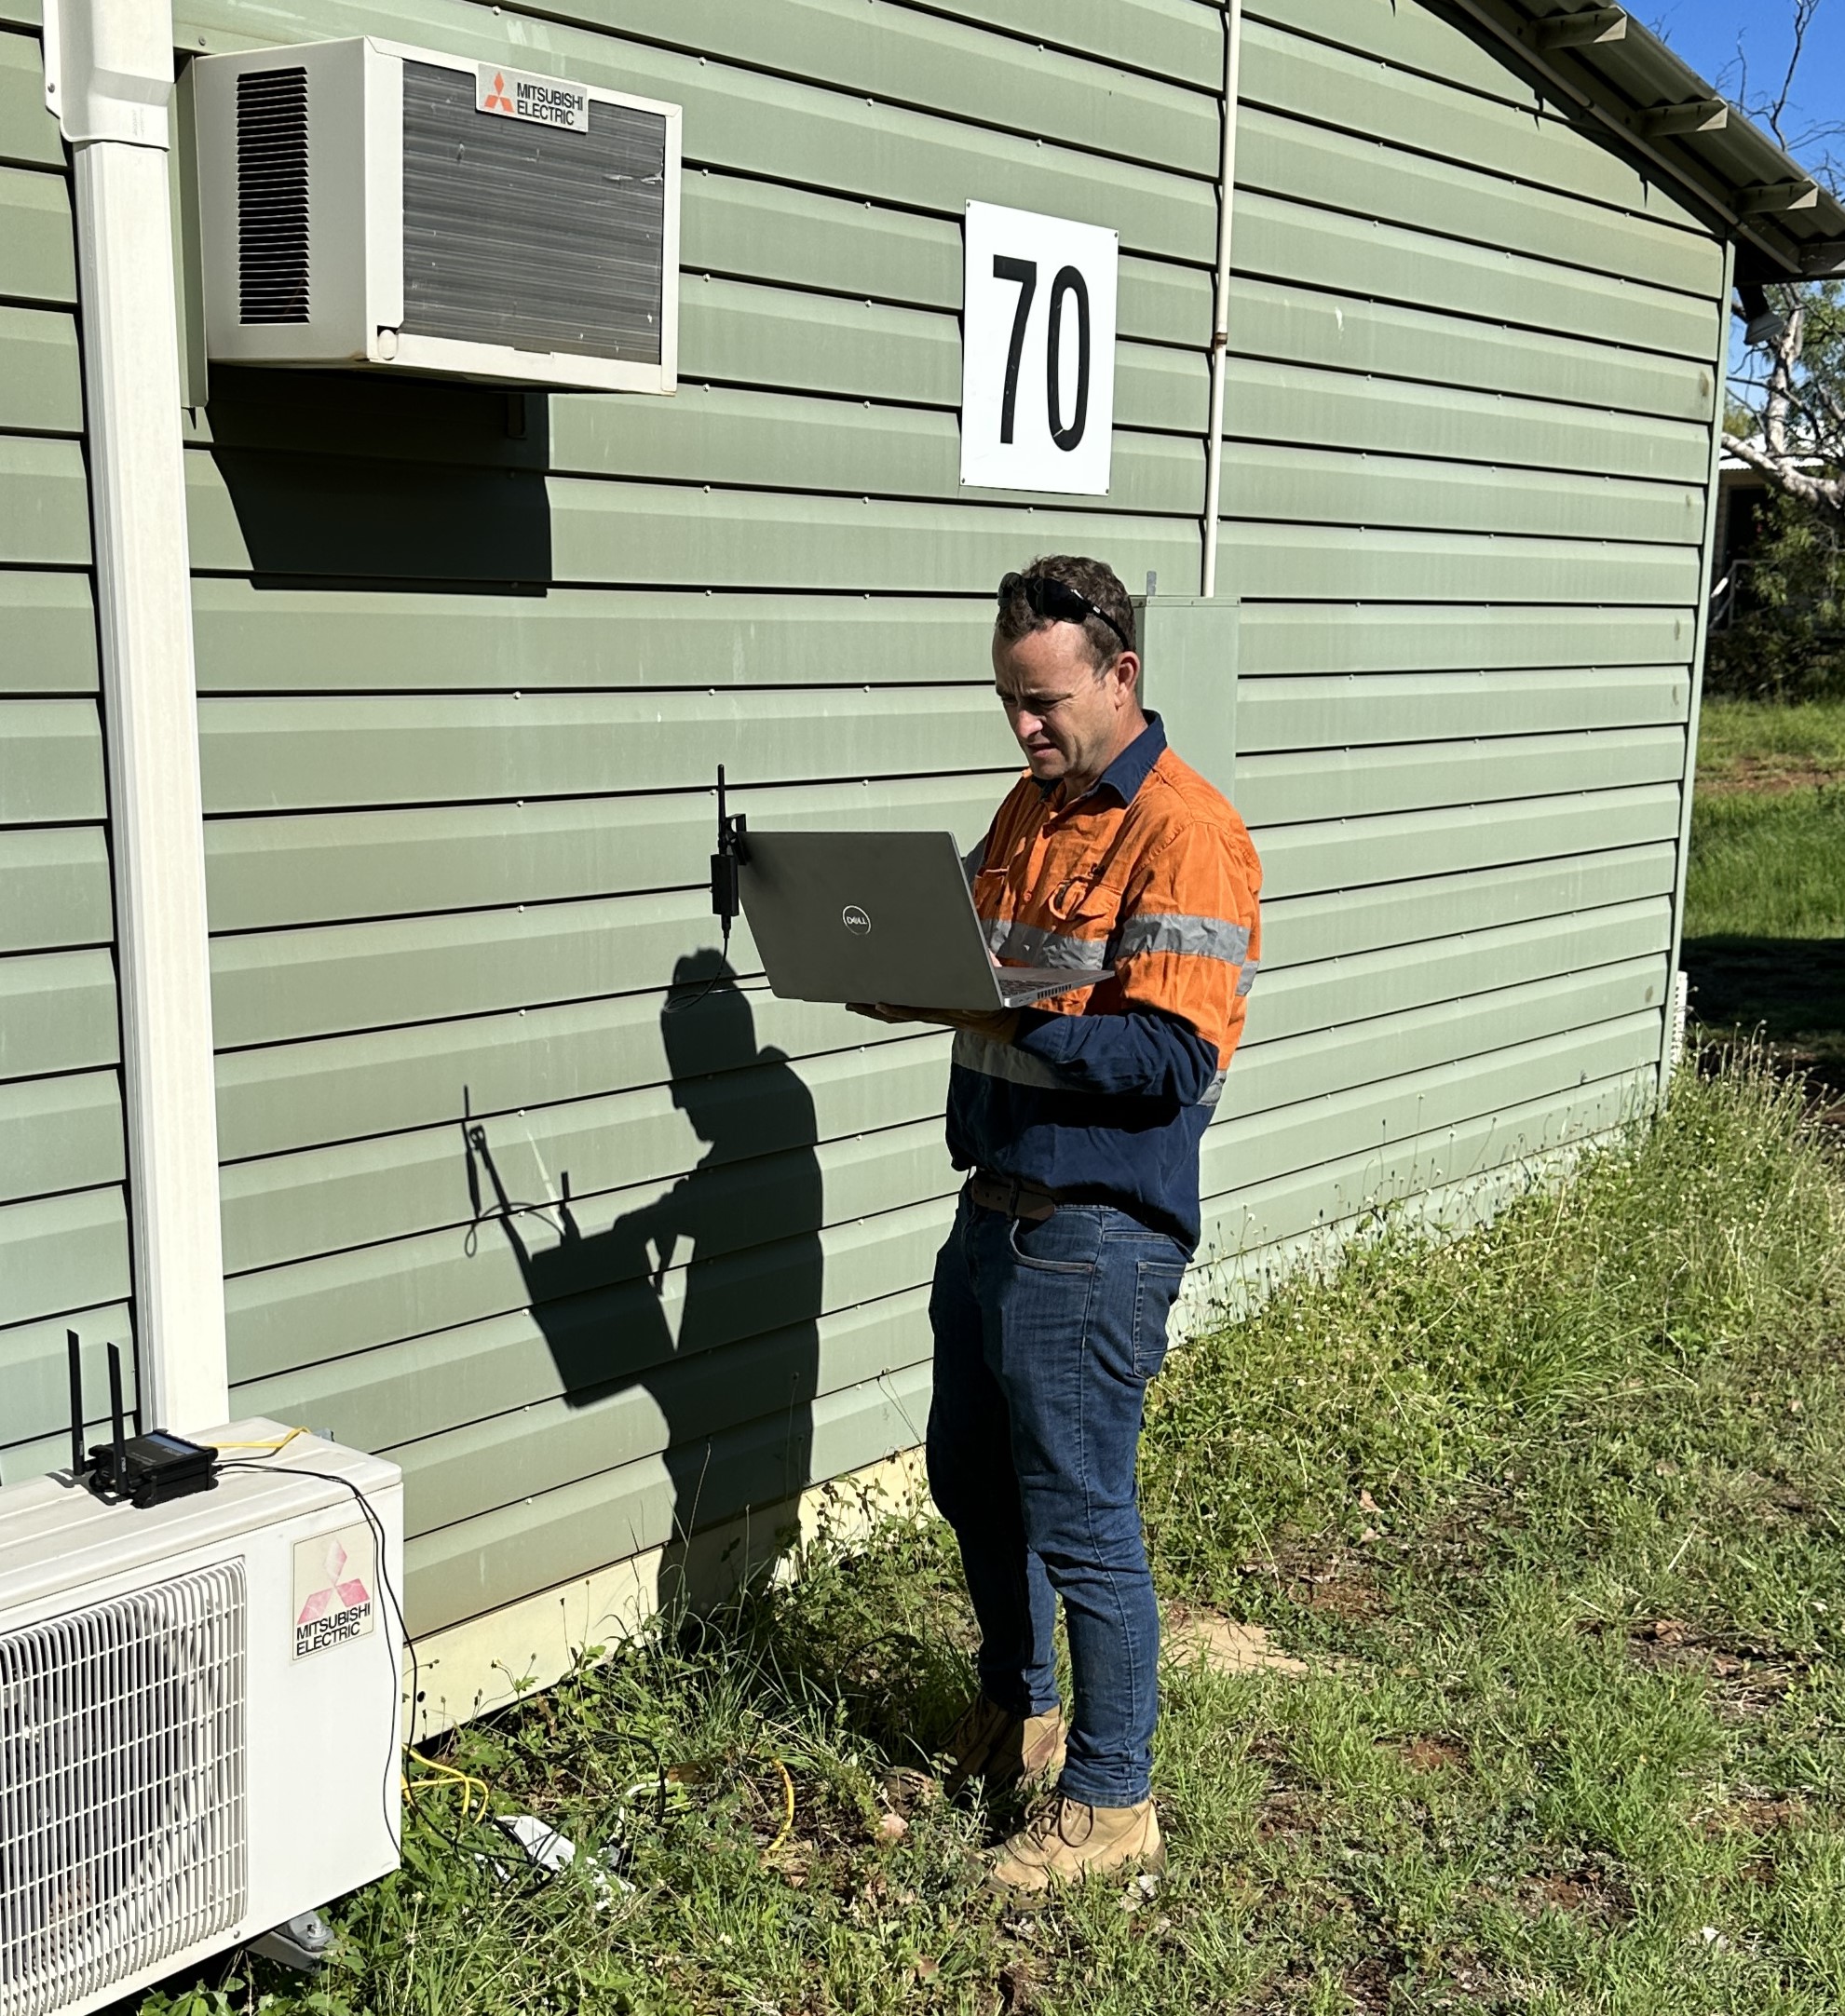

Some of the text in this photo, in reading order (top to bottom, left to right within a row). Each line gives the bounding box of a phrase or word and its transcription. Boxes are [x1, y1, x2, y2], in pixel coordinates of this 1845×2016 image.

[517, 82, 584, 111] MITSUBISHI
[517, 100, 574, 126] ELECTRIC
[993, 254, 1090, 452] 70
[846, 916, 867, 925] DELL
[296, 1602, 371, 1641] MITSUBISHI
[296, 1621, 360, 1656] ELECTRIC
